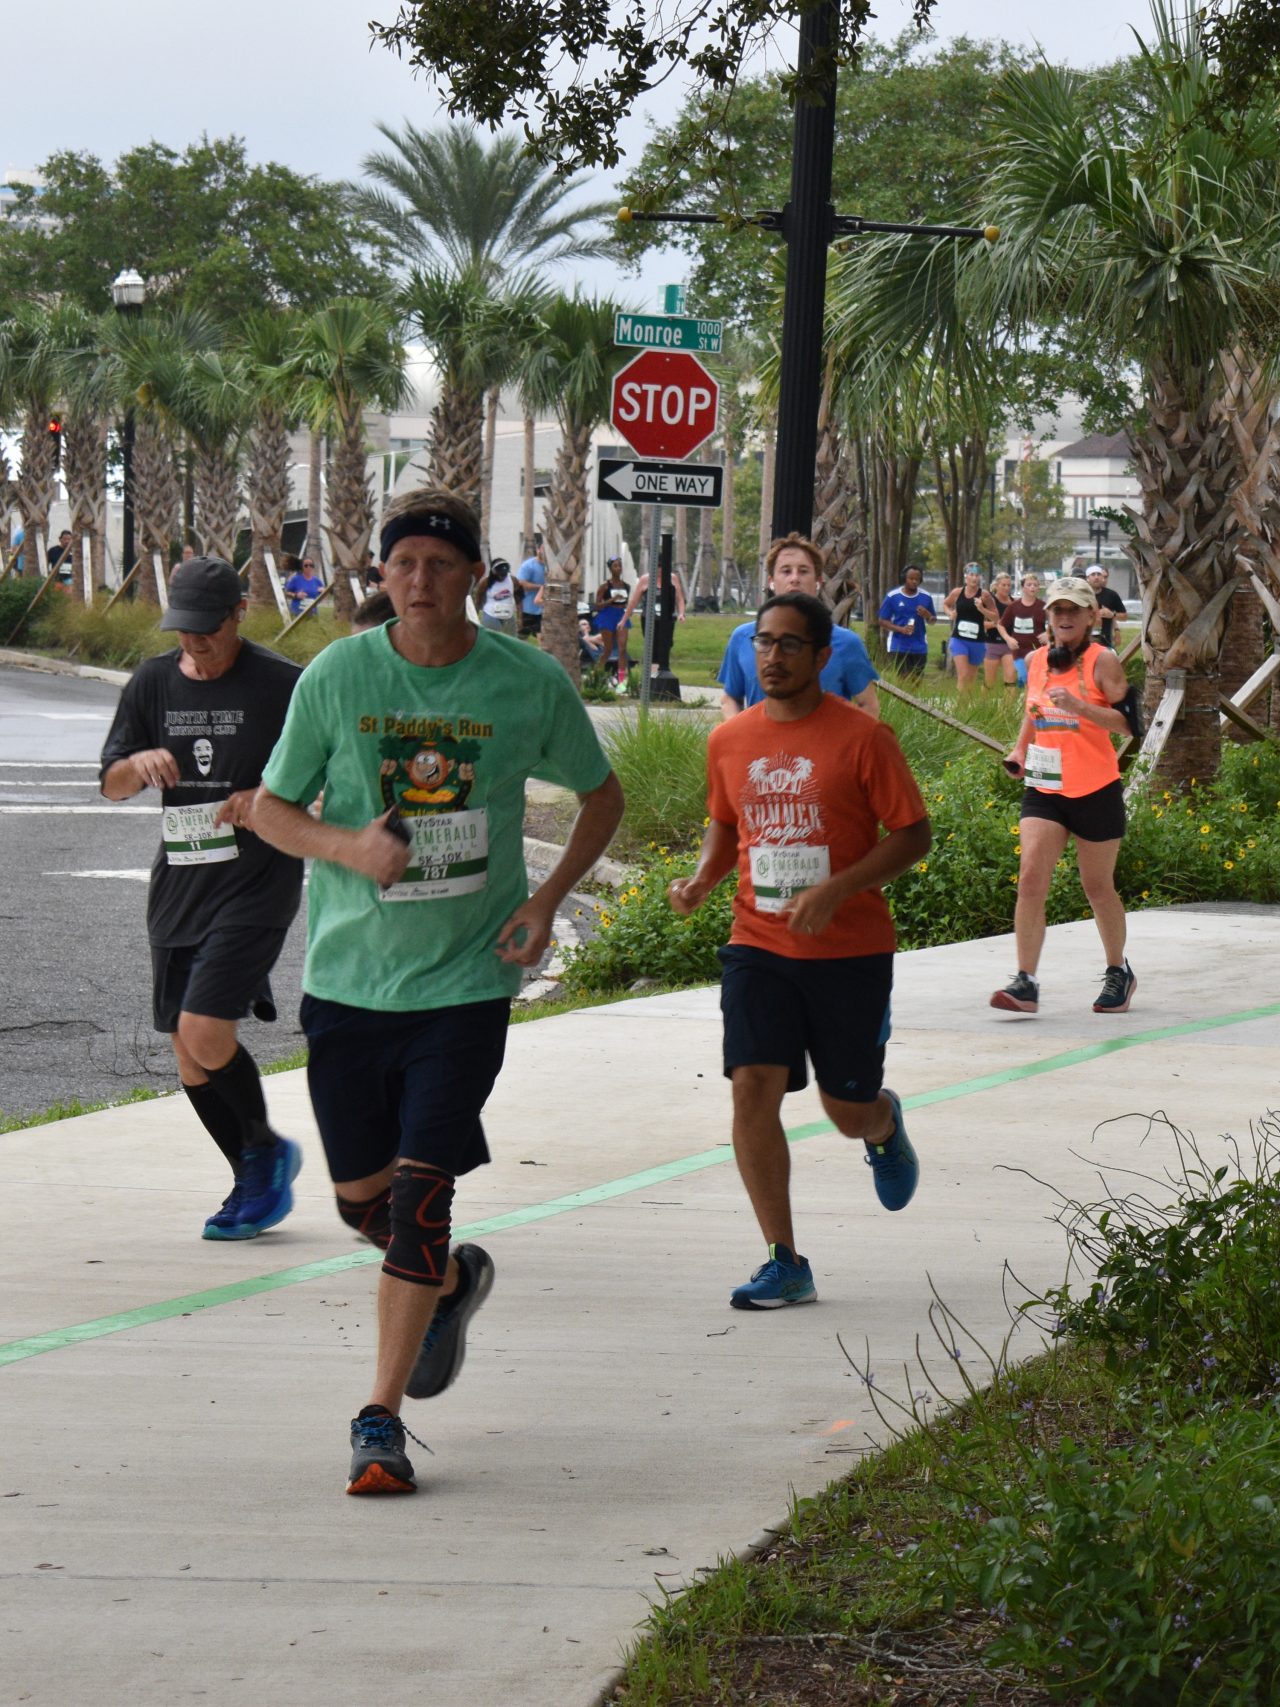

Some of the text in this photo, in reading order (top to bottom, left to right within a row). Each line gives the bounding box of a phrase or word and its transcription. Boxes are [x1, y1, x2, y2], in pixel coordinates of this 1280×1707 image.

[618, 317, 683, 346] Monroe
[697, 322, 720, 335] 1000
[698, 337, 719, 350] St W
[618, 382, 711, 426] STOP
[635, 474, 709, 493] ONE WAY
[164, 710, 244, 727] JUSTIN TIME
[359, 715, 494, 738] St Paddy's Run
[213, 725, 237, 736] CLUB
[179, 811, 219, 827] EMERAL
[744, 803, 823, 832] SUMMER
[184, 831, 213, 841] 5K-10K
[415, 823, 477, 846] EMERALD
[747, 818, 813, 847] League
[190, 841, 201, 851] 11
[418, 852, 463, 865] 5K-10K
[772, 857, 820, 871] EMERALD
[422, 865, 449, 880] 787
